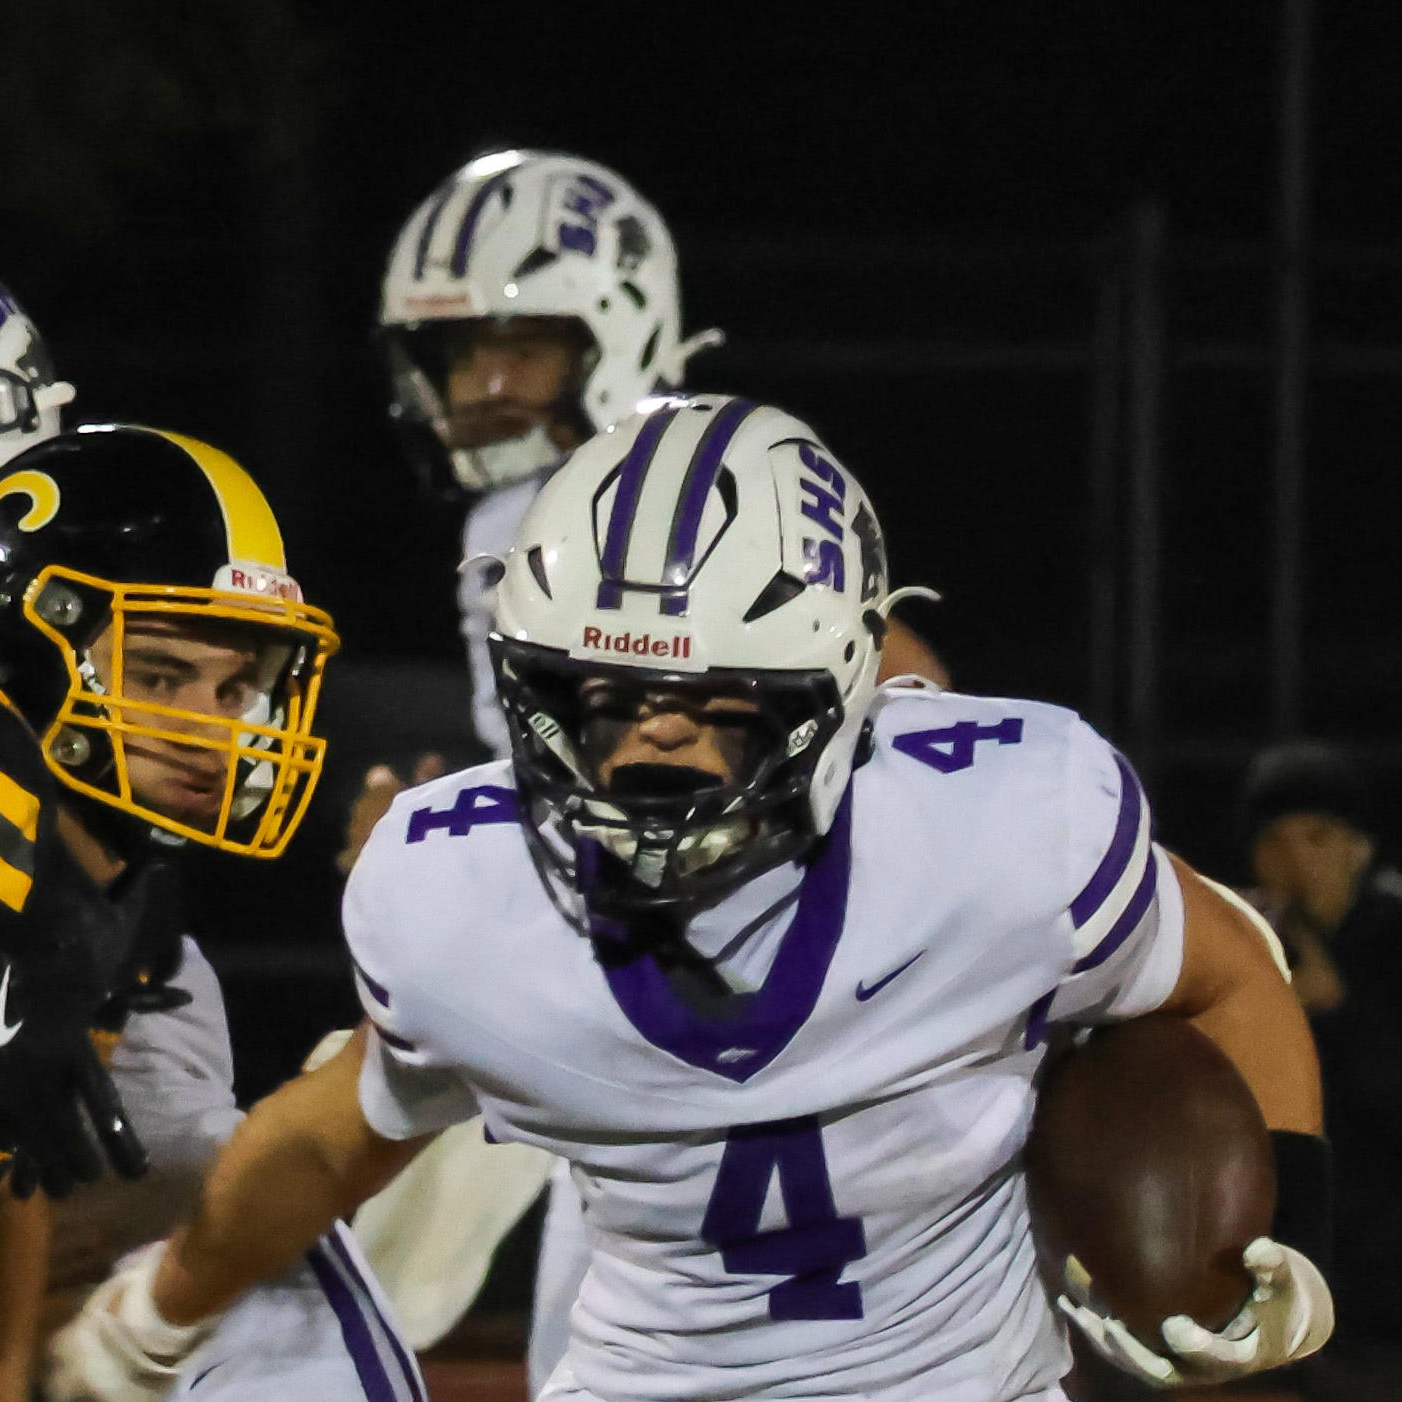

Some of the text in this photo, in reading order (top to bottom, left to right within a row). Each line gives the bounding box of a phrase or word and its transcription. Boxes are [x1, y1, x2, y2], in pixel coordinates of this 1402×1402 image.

[798, 444, 847, 593] SHS
[583, 626, 691, 658] Riddell
[893, 718, 1024, 775] 4
[405, 784, 520, 846] 4
[700, 1113, 868, 1321] 4
